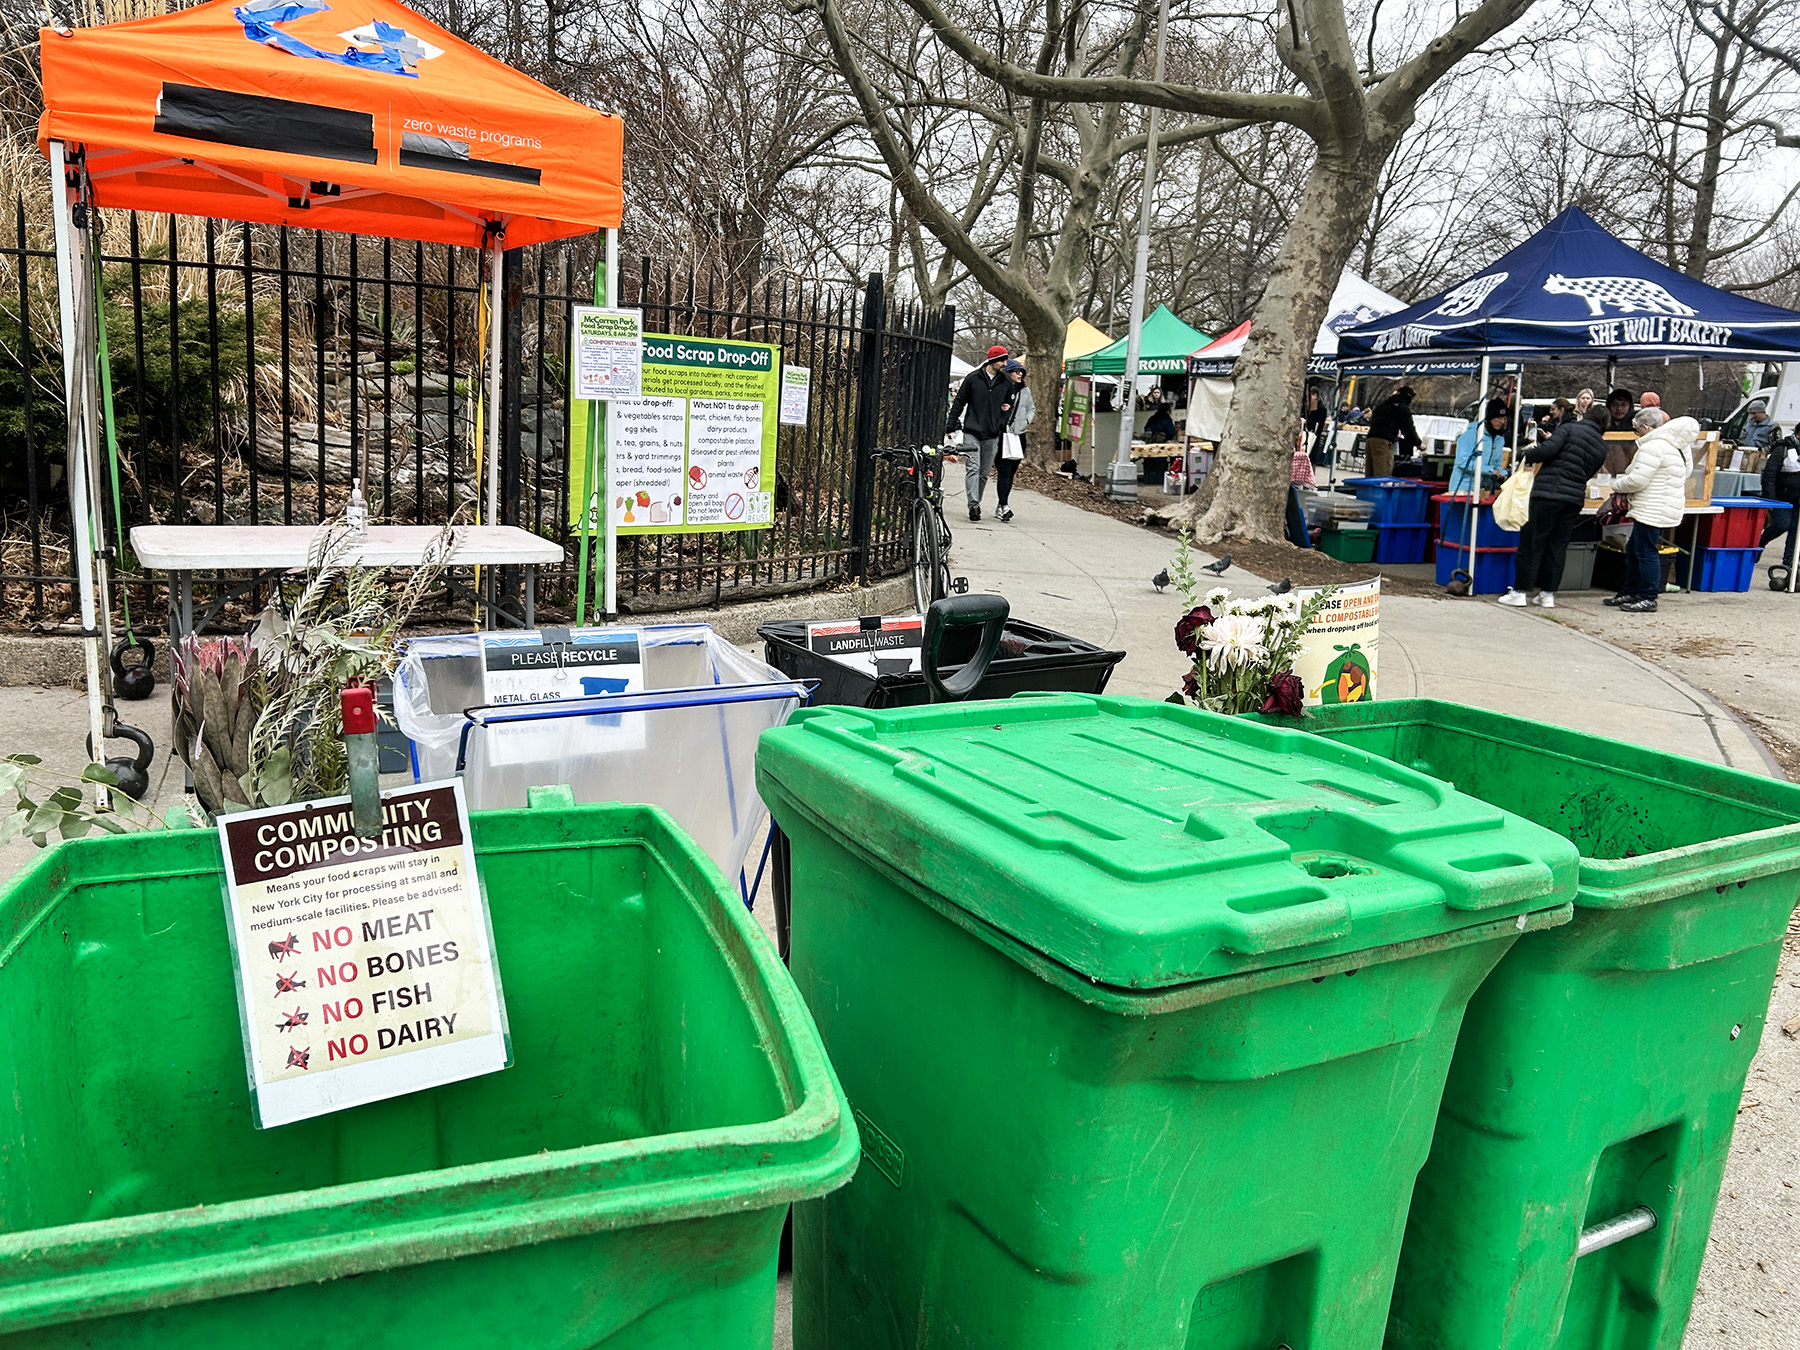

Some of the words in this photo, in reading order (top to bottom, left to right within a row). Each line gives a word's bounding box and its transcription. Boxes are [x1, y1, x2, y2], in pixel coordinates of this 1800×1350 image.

[403, 118, 433, 132] zero
[437, 124, 477, 139] waste
[480, 131, 542, 149] programs
[584, 316, 618, 324] McCarren
[597, 323, 613, 331] Scrap
[1588, 322, 1620, 346] SHE
[1624, 317, 1668, 344] WOLF
[642, 342, 674, 359] Food
[677, 345, 715, 365] Scrap
[718, 348, 769, 367] Drop-Off
[653, 367, 668, 375] food
[642, 376, 661, 384] erials
[674, 378, 703, 387] processed
[704, 378, 722, 387] locally,
[690, 388, 714, 397] gardens,
[643, 398, 675, 408] drop-off:
[693, 401, 712, 409] What
[616, 410, 622, 419] &
[624, 412, 661, 421] vegetables
[662, 414, 683, 422] scraps
[625, 426, 638, 434] egg
[707, 425, 721, 434] dairy
[723, 426, 747, 434] products
[639, 440, 661, 448] grains,
[663, 439, 668, 447] &
[698, 437, 734, 445] compostable
[735, 437, 755, 445] plastics
[627, 452, 632, 460] &
[634, 453, 649, 461] yard
[651, 453, 681, 462] trimmings
[725, 448, 759, 457] pest-infested
[717, 460, 735, 468] plants
[633, 479, 671, 487] (shredded!)
[700, 514, 720, 522] plastic!
[1319, 599, 1341, 610] EASE
[1343, 597, 1362, 608] OPEN
[1363, 594, 1374, 605] AND
[1326, 607, 1374, 623] COMPOSTABLE
[1327, 624, 1355, 633] dropping
[1364, 620, 1374, 628] food
[830, 638, 875, 651] LANDFILL
[875, 635, 904, 647] WASTE
[511, 652, 558, 665] PLEASE
[561, 649, 618, 663] RECYCLE
[530, 691, 561, 701] GLASS
[254, 820, 443, 873] COMPOSTING
[266, 881, 300, 895] Means
[302, 876, 326, 890] your
[328, 870, 350, 883] food
[353, 864, 387, 880] scraps
[388, 860, 405, 872] will
[407, 857, 428, 871] stay
[430, 854, 440, 864] in
[252, 902, 275, 915] New
[277, 897, 301, 910] York
[303, 892, 323, 908] City
[325, 889, 341, 900] for
[342, 879, 398, 900] processing
[399, 876, 409, 887] at
[411, 872, 438, 884] small
[439, 867, 458, 878] and
[250, 909, 323, 932] medium-scale
[325, 901, 371, 918] facilities.
[372, 895, 405, 908] Please
[406, 890, 419, 901] be
[422, 883, 462, 899] advised:
[312, 925, 353, 952] NO
[361, 908, 434, 943] MEAT
[316, 961, 358, 988] NO
[366, 940, 460, 979] BONES
[322, 997, 363, 1025] NO
[371, 982, 432, 1014] FISH
[327, 1033, 369, 1062] NO
[377, 1012, 458, 1050] DAIRY
